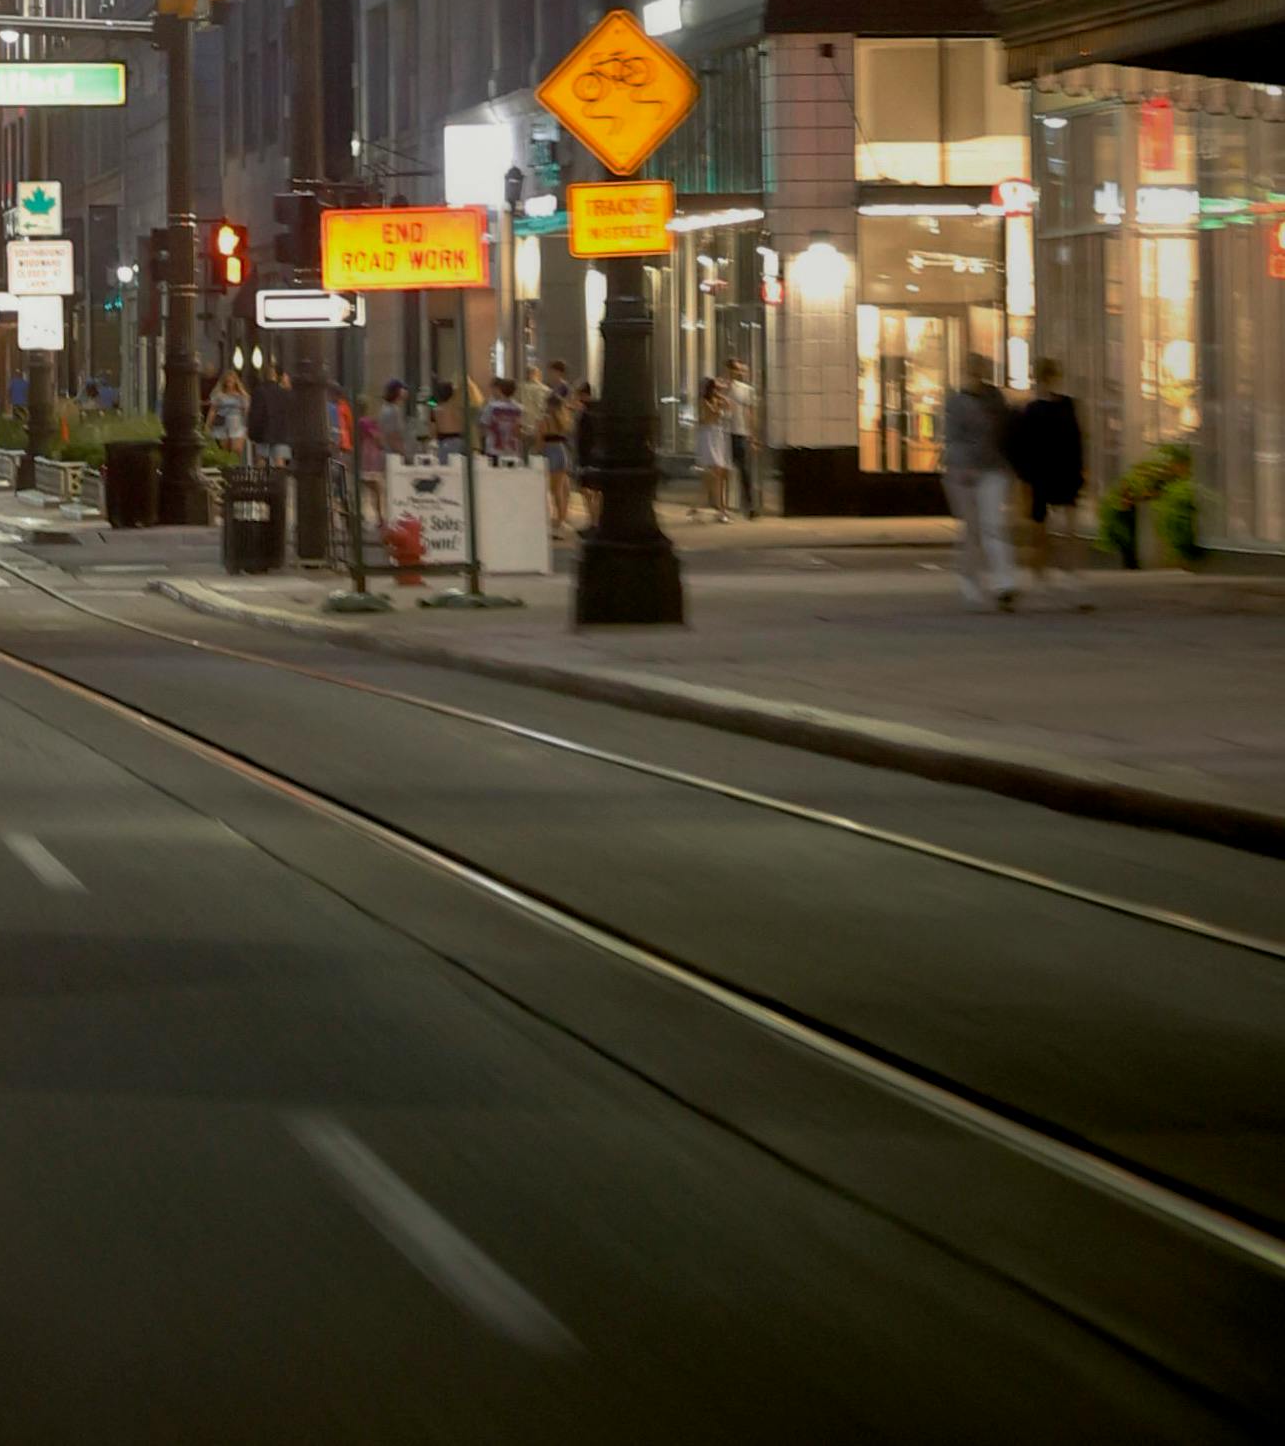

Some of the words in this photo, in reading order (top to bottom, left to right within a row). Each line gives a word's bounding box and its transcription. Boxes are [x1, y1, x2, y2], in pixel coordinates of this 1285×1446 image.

[382, 222, 424, 244] END
[342, 248, 396, 273] ROAD
[409, 248, 468, 272] WORK
